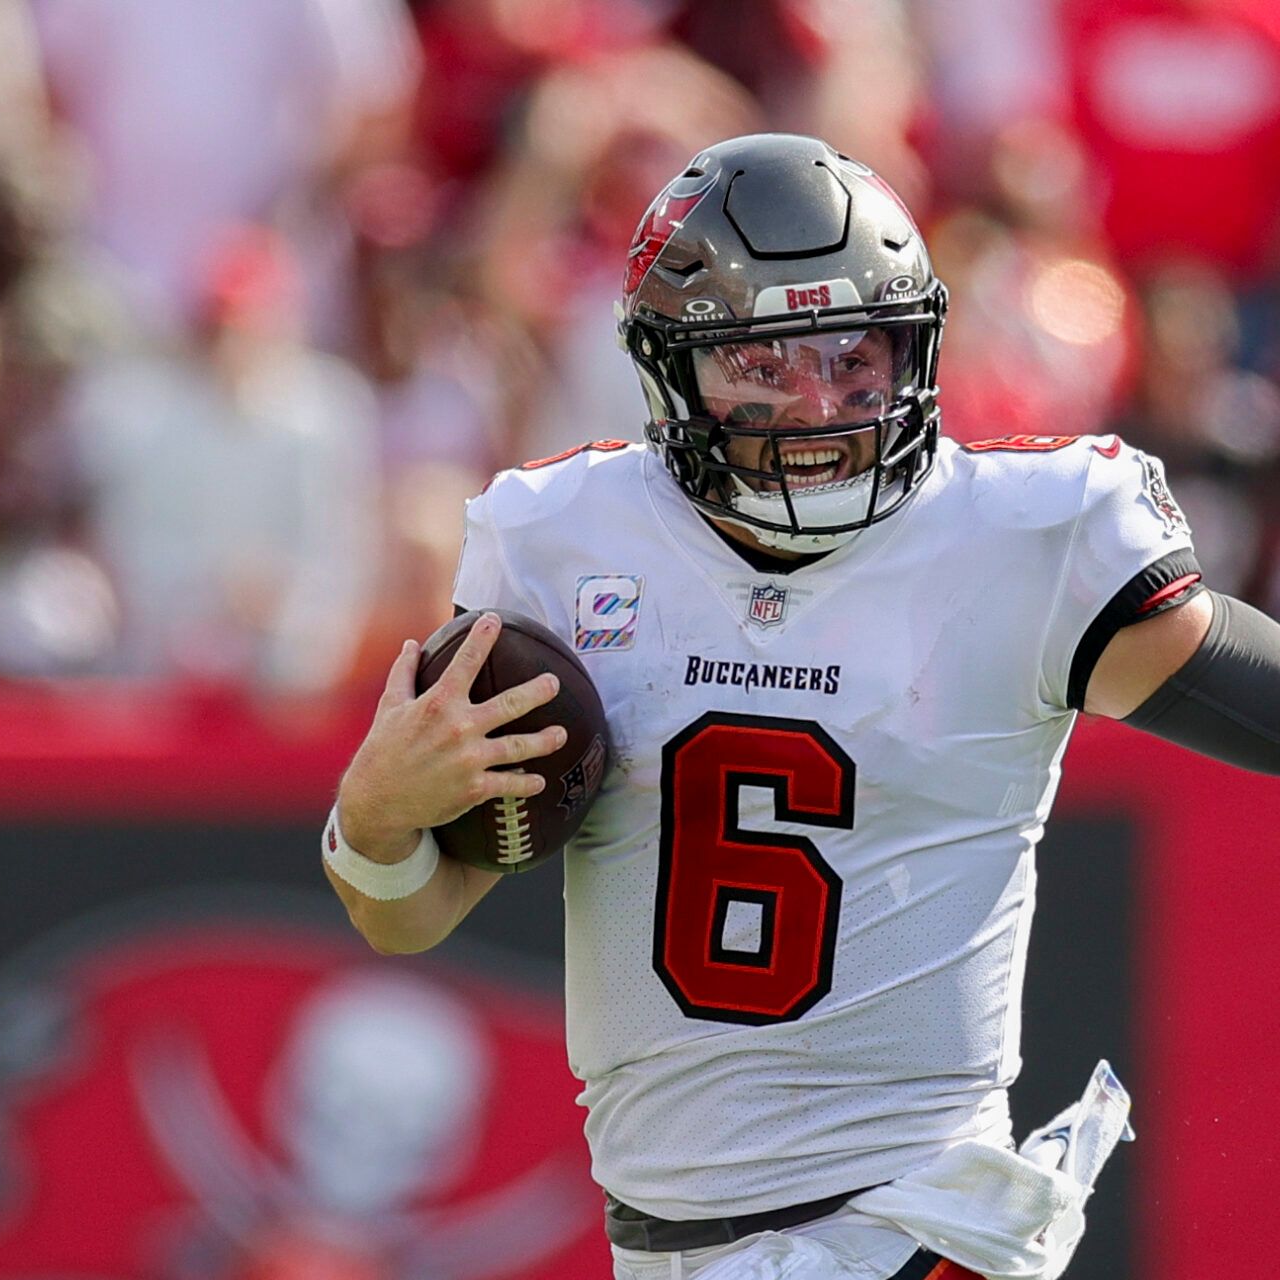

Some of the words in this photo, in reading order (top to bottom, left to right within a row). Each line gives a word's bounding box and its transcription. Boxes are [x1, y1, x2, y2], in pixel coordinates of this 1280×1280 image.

[785, 284, 832, 311] BUCS
[681, 312, 725, 323] OAKLEY
[579, 579, 637, 631] C
[753, 600, 780, 620] NFL
[683, 655, 841, 695] BUCCANEERS
[652, 710, 857, 1027] 6
